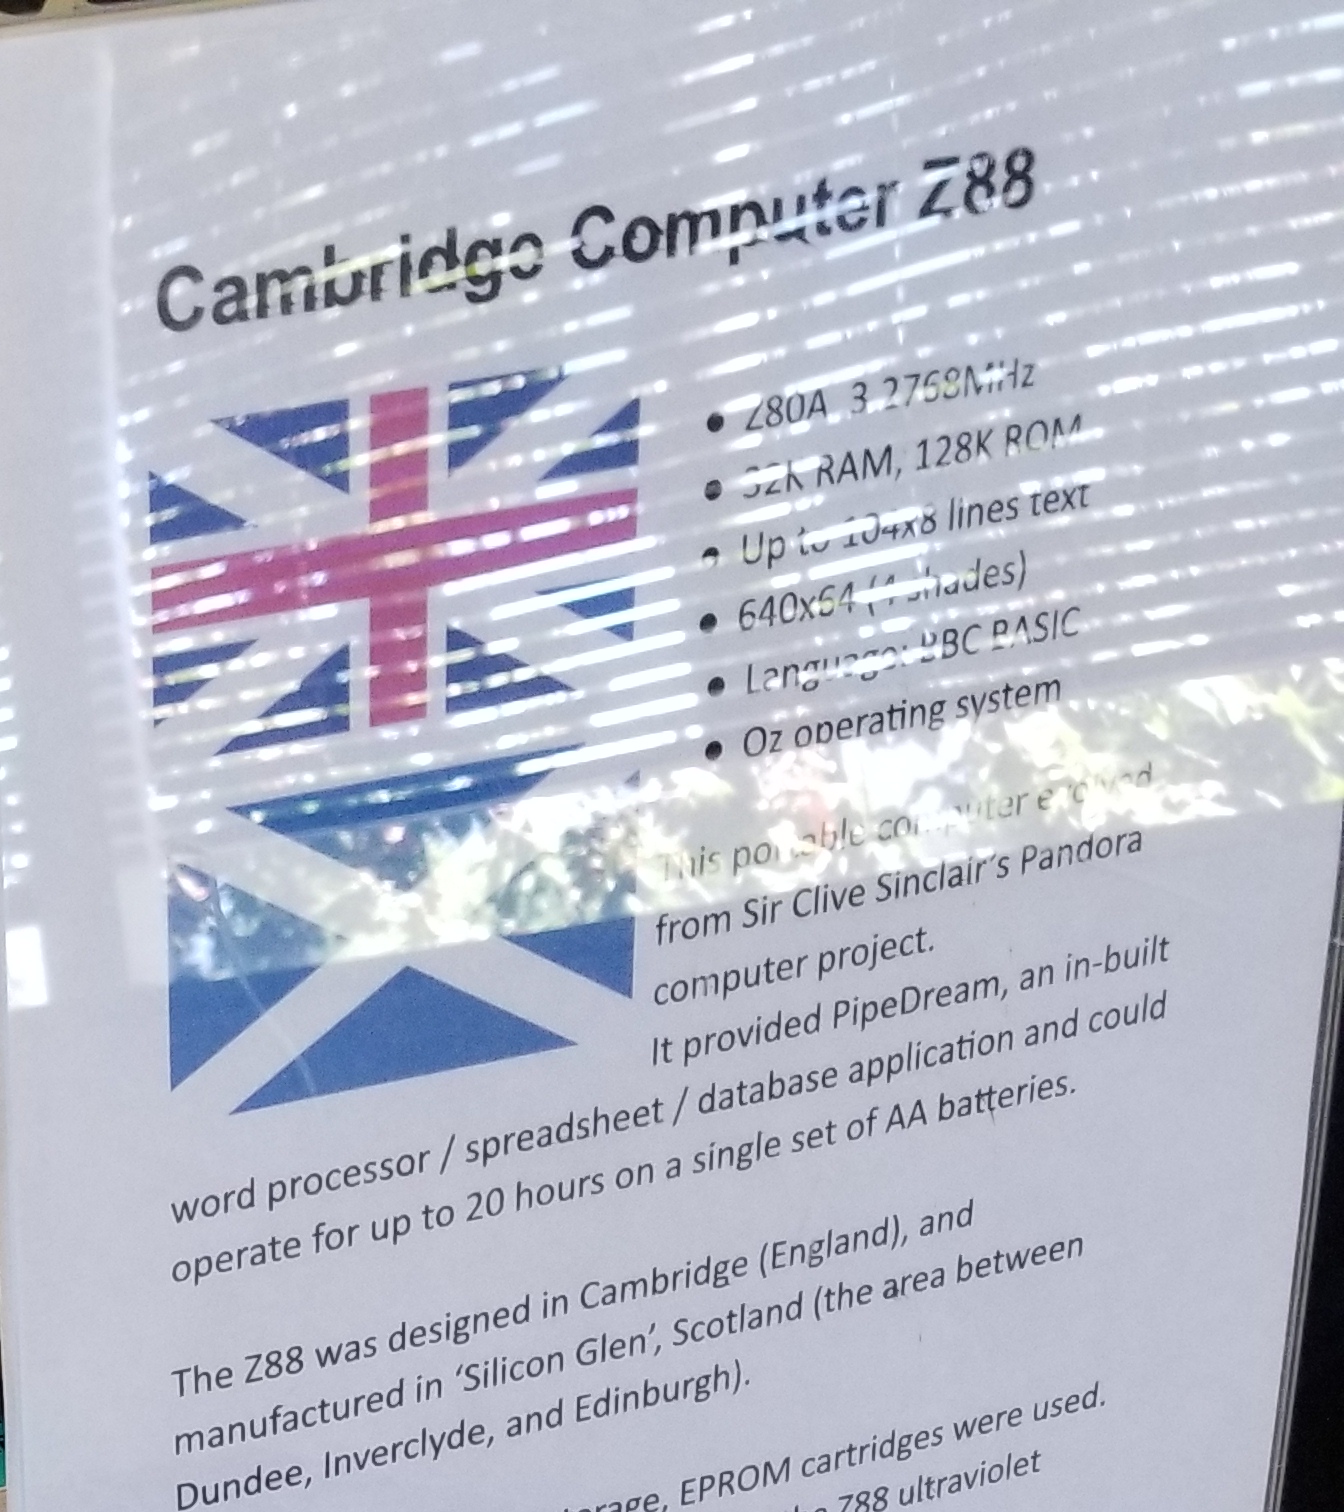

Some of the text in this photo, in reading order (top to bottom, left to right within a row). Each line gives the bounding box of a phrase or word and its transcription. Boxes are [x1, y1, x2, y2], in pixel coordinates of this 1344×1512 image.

[157, 147, 1035, 332] Cambridge Computer Z88
[743, 678, 1061, 757] Oz operating system
[656, 910, 730, 947] from
[743, 894, 784, 928] Sir
[793, 881, 865, 923] Clive
[1021, 830, 1142, 876] Pandora
[653, 934, 1170, 1067] It provided PipeDream, an in-built
[654, 926, 934, 1006] computer project.
[171, 989, 1167, 1224] word processor / spreadsheet / database application and could
[172, 1074, 1076, 1287] operate for up to 20 hours on a single set of AA batteries.
[171, 1198, 974, 1398] The Z88 was designed in Cambridge (England), and
[175, 1377, 405, 1455] manufactured
[417, 1374, 442, 1403] in
[672, 1290, 803, 1346] Scotland
[814, 1281, 873, 1321] (the
[883, 1268, 945, 1299] area
[956, 1237, 1083, 1284] between
[177, 1358, 750, 1511] Dundee, Inverclyde, and Edinburgh).
[681, 1456, 790, 1506] EPROM
[801, 1426, 943, 1477] cartridges
[953, 1408, 1022, 1441] were
[1034, 1380, 1105, 1421] used.
[899, 1450, 1041, 1506] ultraviolet
